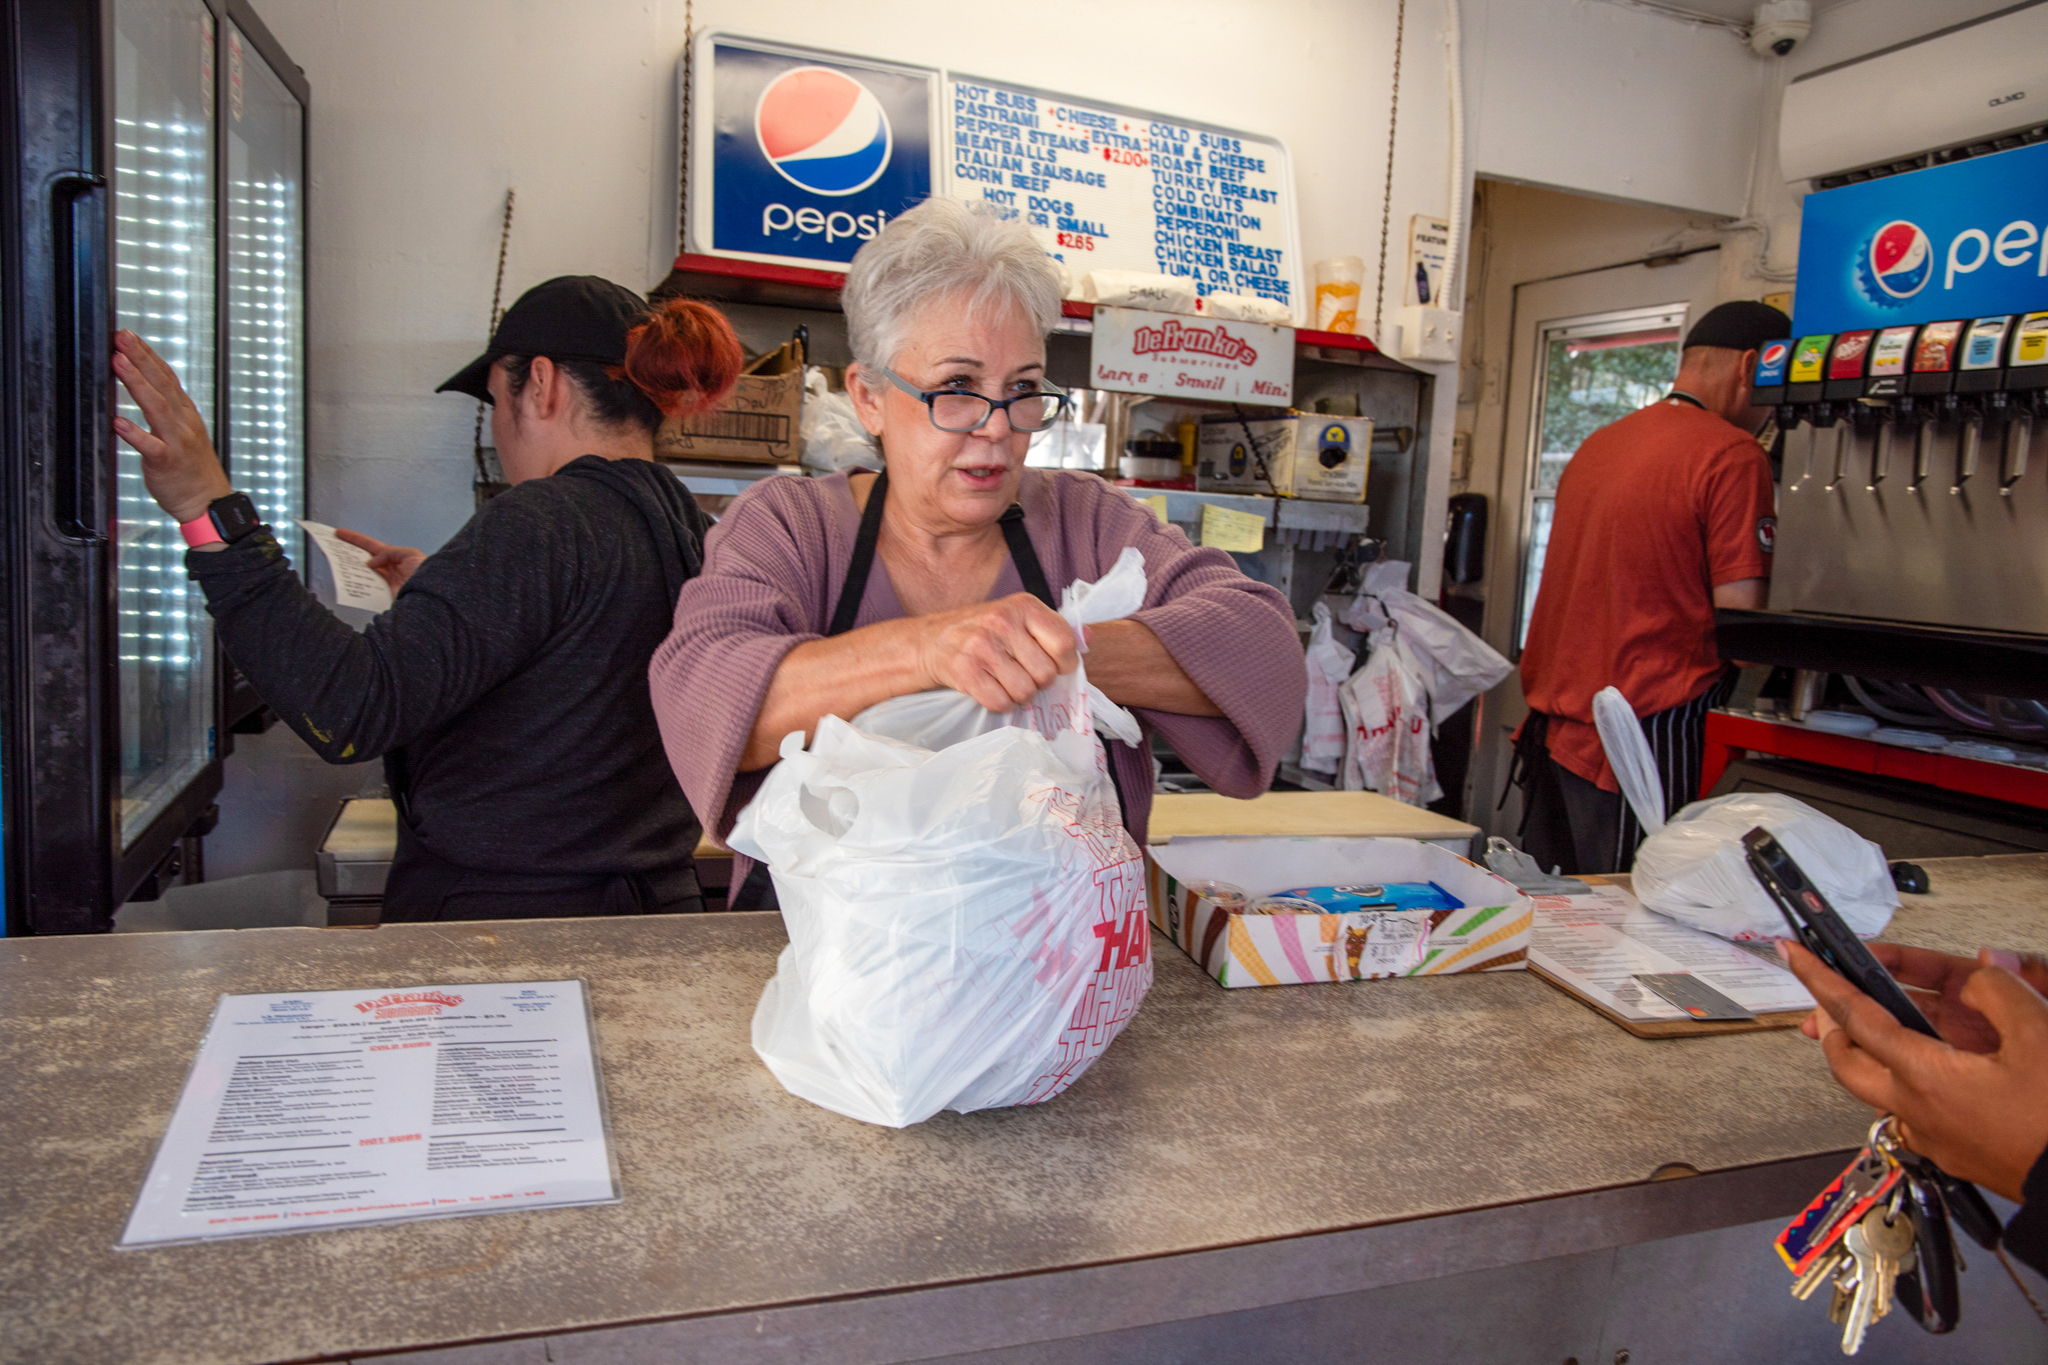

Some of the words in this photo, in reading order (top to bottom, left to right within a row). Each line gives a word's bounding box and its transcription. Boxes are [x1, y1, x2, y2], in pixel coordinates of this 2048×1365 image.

[955, 82, 989, 102] HOT
[994, 91, 1037, 112] SUBS
[954, 98, 1039, 128] PASTRAMI
[1056, 107, 1117, 131] CHEESE
[954, 114, 1021, 140] PEPPER
[1028, 129, 1090, 153] STEAKS
[954, 131, 1057, 163] MEATBALLS
[1092, 129, 1142, 151] EXTRA
[1149, 121, 1190, 143] COLD
[1199, 133, 1241, 153] SUBS
[955, 146, 1023, 172] ITALIAN
[1031, 161, 1106, 188] SAUSAGE
[1149, 138, 1185, 157] HAM
[1192, 147, 1202, 160] &
[1208, 150, 1266, 173] CHEESE
[1150, 153, 1203, 175] ROAST
[1209, 165, 1246, 183] BEEF
[955, 163, 1003, 185] CORN
[1011, 173, 1050, 192] BEEF
[1151, 169, 1216, 192] TURKEY
[1220, 181, 1278, 204] BREAST
[983, 186, 1017, 206] HOT
[1028, 195, 1074, 216] DOGS
[1153, 184, 1196, 204] COLD
[1201, 193, 1244, 212] CUTS
[762, 202, 887, 244] pepsi
[1027, 211, 1050, 228] OR
[1056, 216, 1109, 238] SMALL
[1153, 199, 1261, 231] COMBINATION
[1155, 214, 1240, 241] PEPPERONI
[1154, 230, 1223, 253] CHICKEN
[1227, 241, 1283, 263] BREAST
[1416, 234, 1448, 246] FEATUR
[1154, 245, 1224, 269] CHICKEN
[1229, 257, 1279, 277] SALAD
[1157, 260, 1203, 280] TUNA
[1208, 269, 1230, 285] OR
[1235, 273, 1291, 295] CHEESE
[1175, 372, 1226, 391] Small
